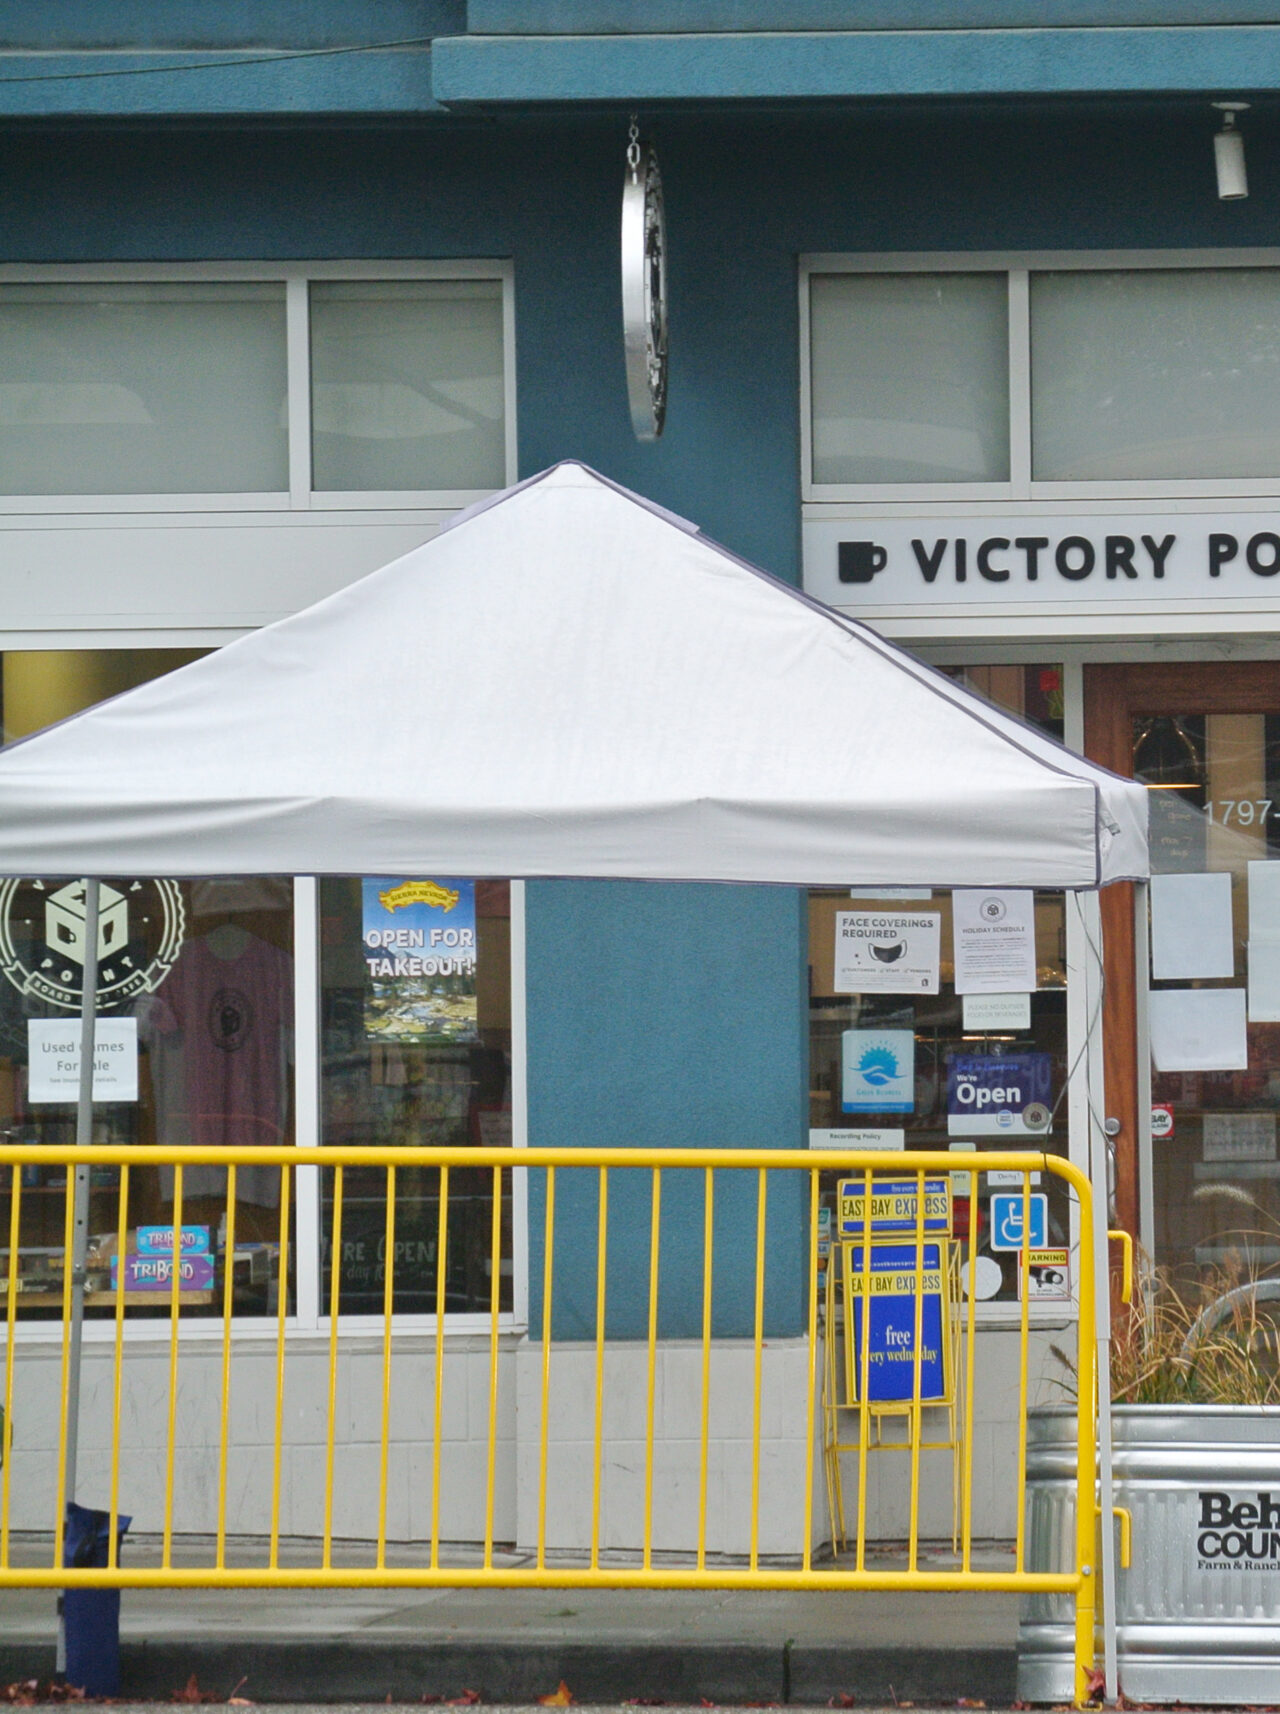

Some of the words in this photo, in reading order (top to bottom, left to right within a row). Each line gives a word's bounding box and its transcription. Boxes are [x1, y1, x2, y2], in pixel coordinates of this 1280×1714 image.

[911, 535, 1175, 582] VICTORY
[842, 918, 869, 927] FACE
[871, 919, 933, 928] COVERINGS
[366, 929, 424, 948] OPEN
[430, 928, 473, 947] FOR
[842, 929, 897, 938] REQUIRED
[40, 956, 133, 983] PONT
[366, 957, 472, 976] TAKEOUT!
[33, 979, 72, 1002] BOARD
[42, 1042, 75, 1053] Used
[57, 1061, 79, 1071] For
[956, 1074, 978, 1082] We're
[956, 1082, 1021, 1108] Open
[829, 1133, 861, 1141] Recording
[871, 1199, 891, 1216] BAY
[895, 1197, 947, 1220] expess
[147, 1230, 196, 1247] TRIBND
[851, 1277, 872, 1292] EAT
[875, 1276, 892, 1292] BAY
[896, 1275, 940, 1295] expess
[885, 1325, 910, 1345] free
[861, 1350, 885, 1367] ery
[886, 1345, 938, 1365] wedneday
[1197, 1560, 1231, 1571] Farm
[1232, 1561, 1243, 1571] &
